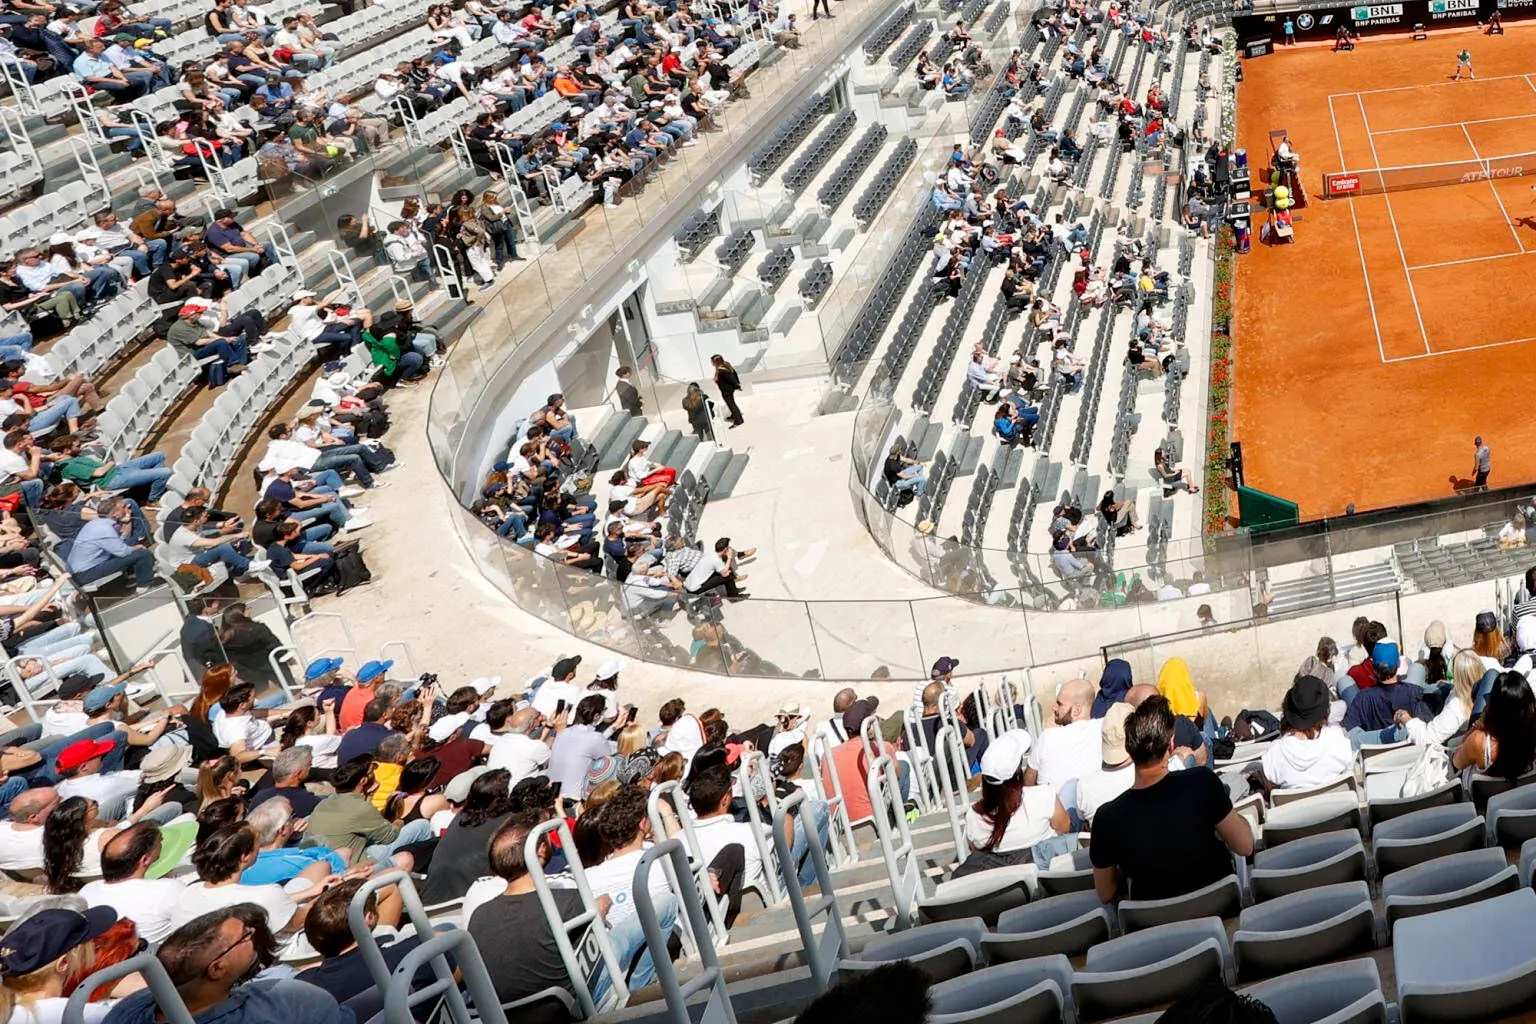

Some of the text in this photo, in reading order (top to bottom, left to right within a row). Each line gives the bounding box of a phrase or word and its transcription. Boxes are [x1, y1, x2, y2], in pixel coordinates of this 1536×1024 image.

[1370, 5, 1400, 17] BNL
[1432, 9, 1477, 20] BNP PARIBAS
[1355, 16, 1400, 27] BNP PARIBAS
[1490, 166, 1523, 179] TOUR
[1332, 178, 1358, 187] Emirates
[579, 932, 600, 977] 10
